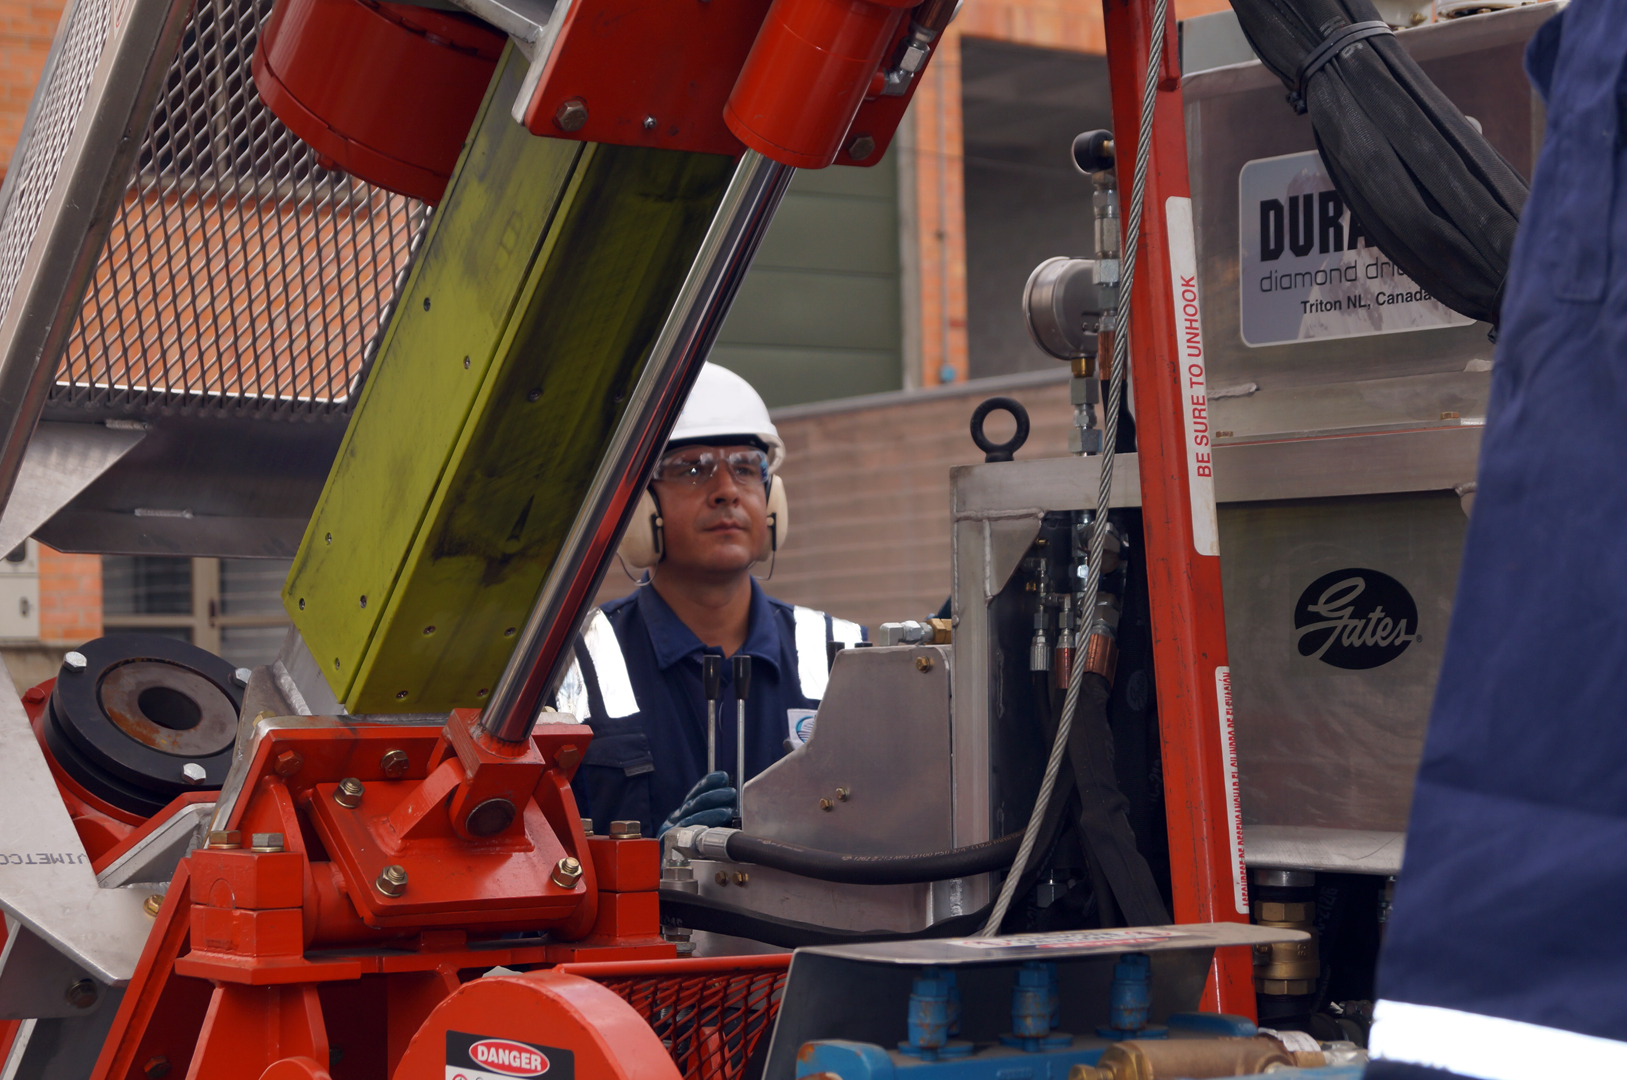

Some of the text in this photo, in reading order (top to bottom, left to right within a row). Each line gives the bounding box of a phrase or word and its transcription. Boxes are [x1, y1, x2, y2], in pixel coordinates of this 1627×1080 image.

[1260, 260, 1358, 293] diamond
[1301, 287, 1432, 315] Triton NL, Canada
[1180, 275, 1212, 477] BE SURE TO UNHOOK
[1295, 574, 1417, 662] Gates
[477, 1045, 542, 1071] DANGER
